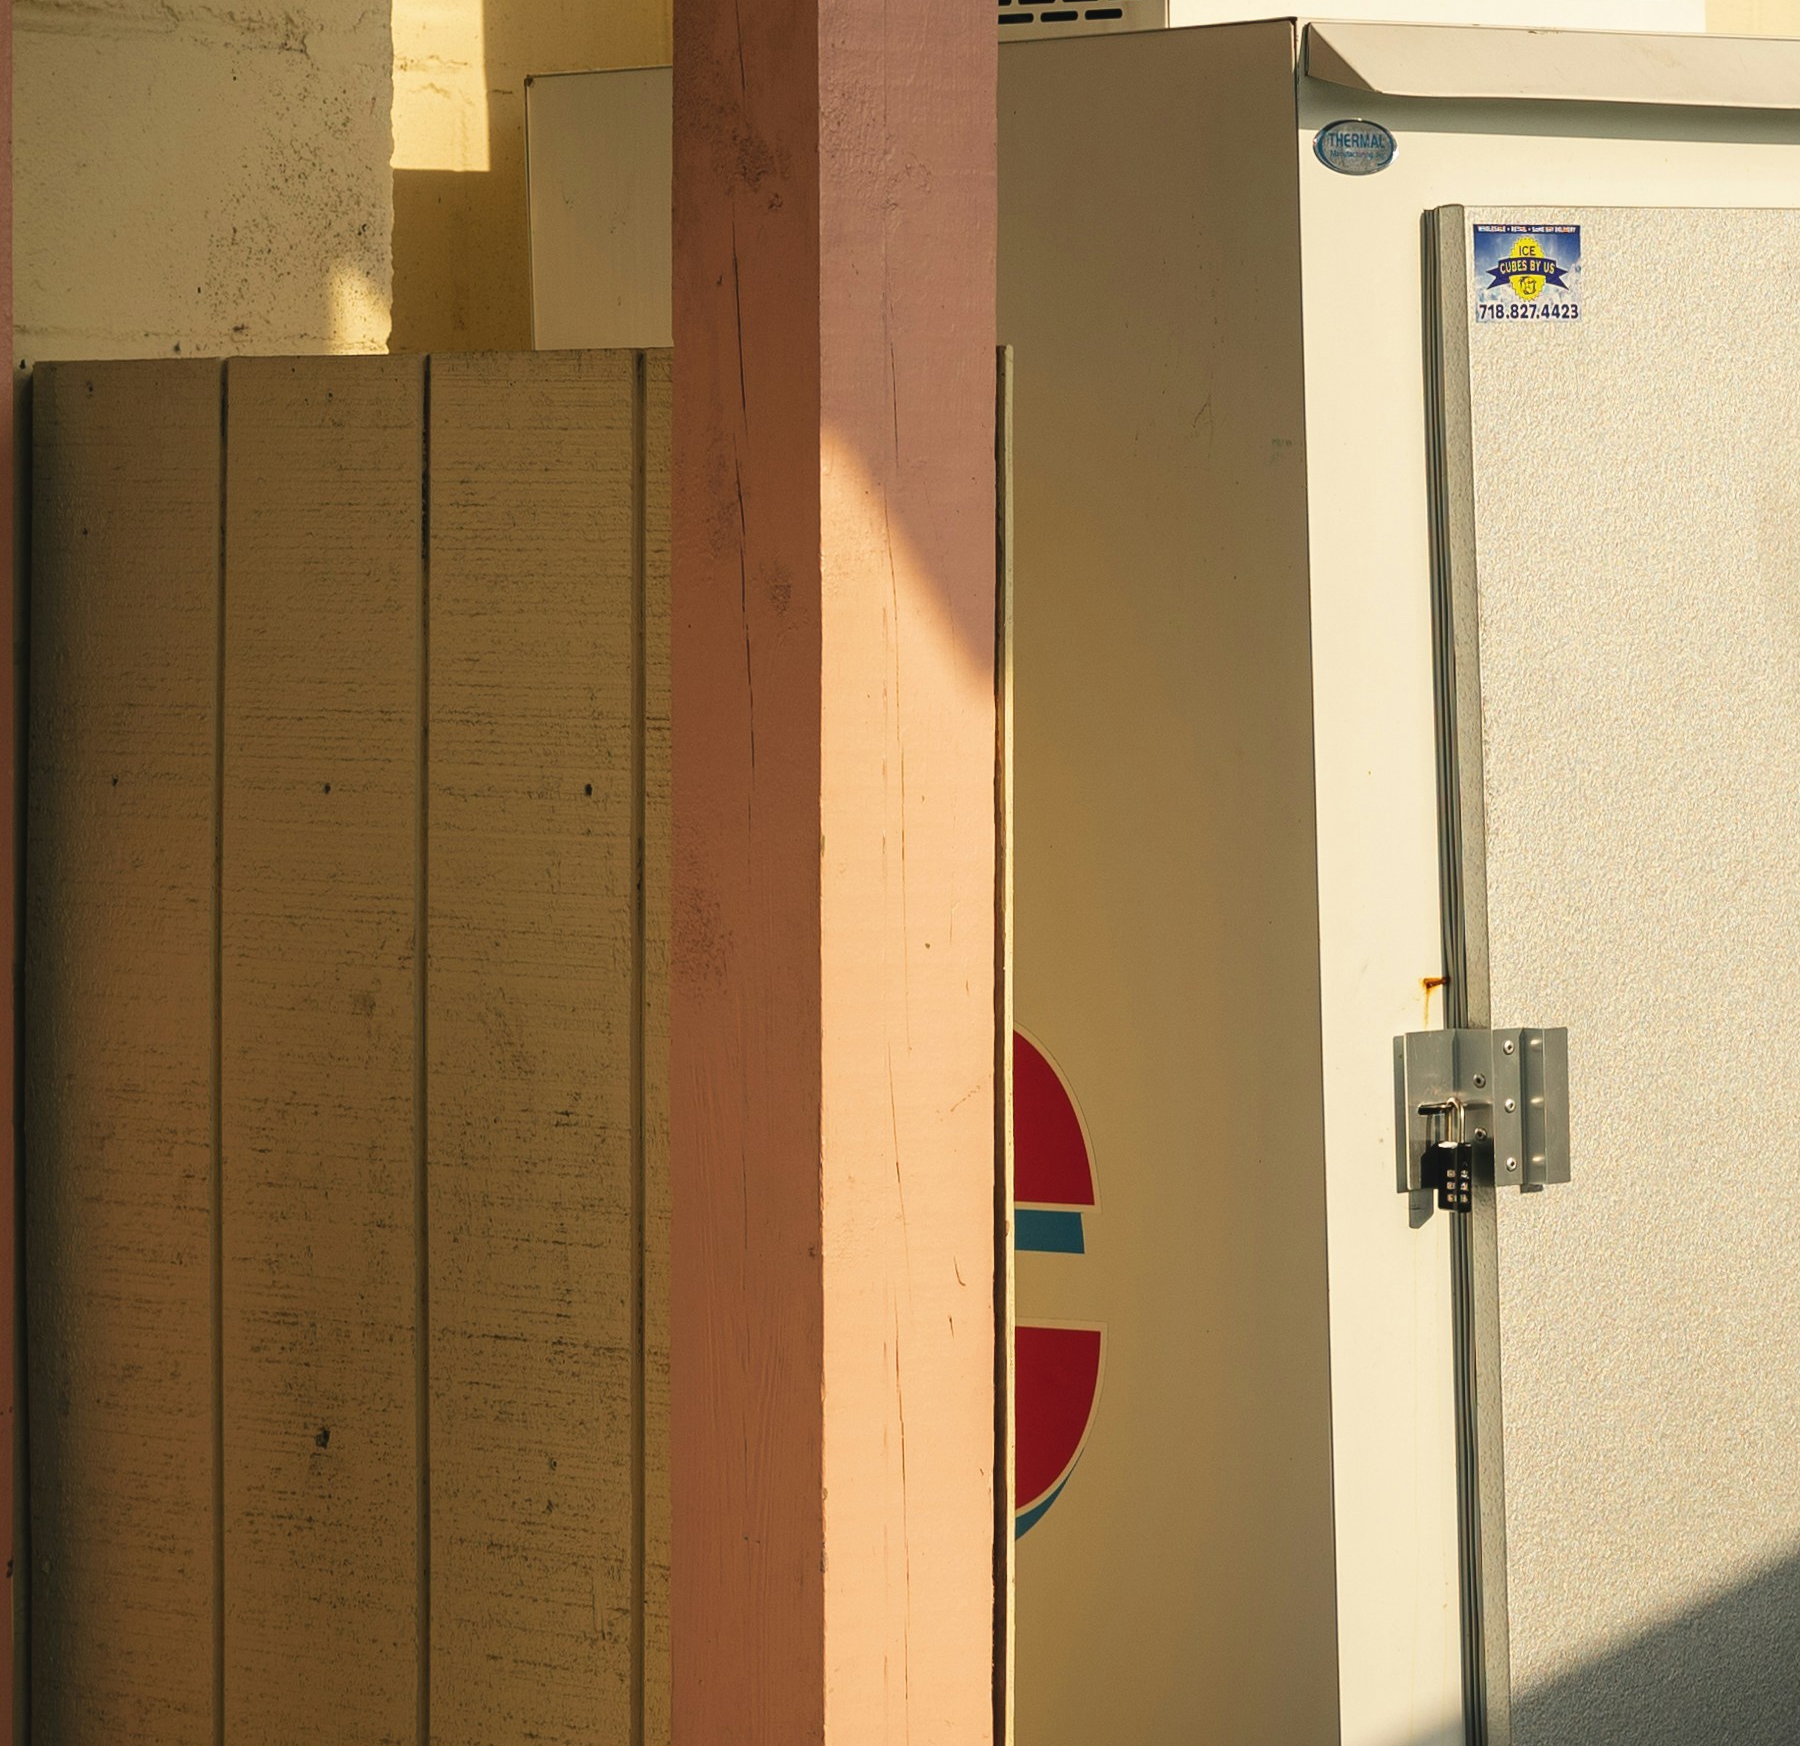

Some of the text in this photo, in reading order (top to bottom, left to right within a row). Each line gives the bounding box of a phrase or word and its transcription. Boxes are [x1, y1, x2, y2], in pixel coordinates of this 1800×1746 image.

[1328, 133, 1385, 149] THERMAL
[1518, 245, 1536, 256] ICE
[1500, 260, 1555, 274] CUBES BY US
[1479, 303, 1579, 320] 718.827.4423
